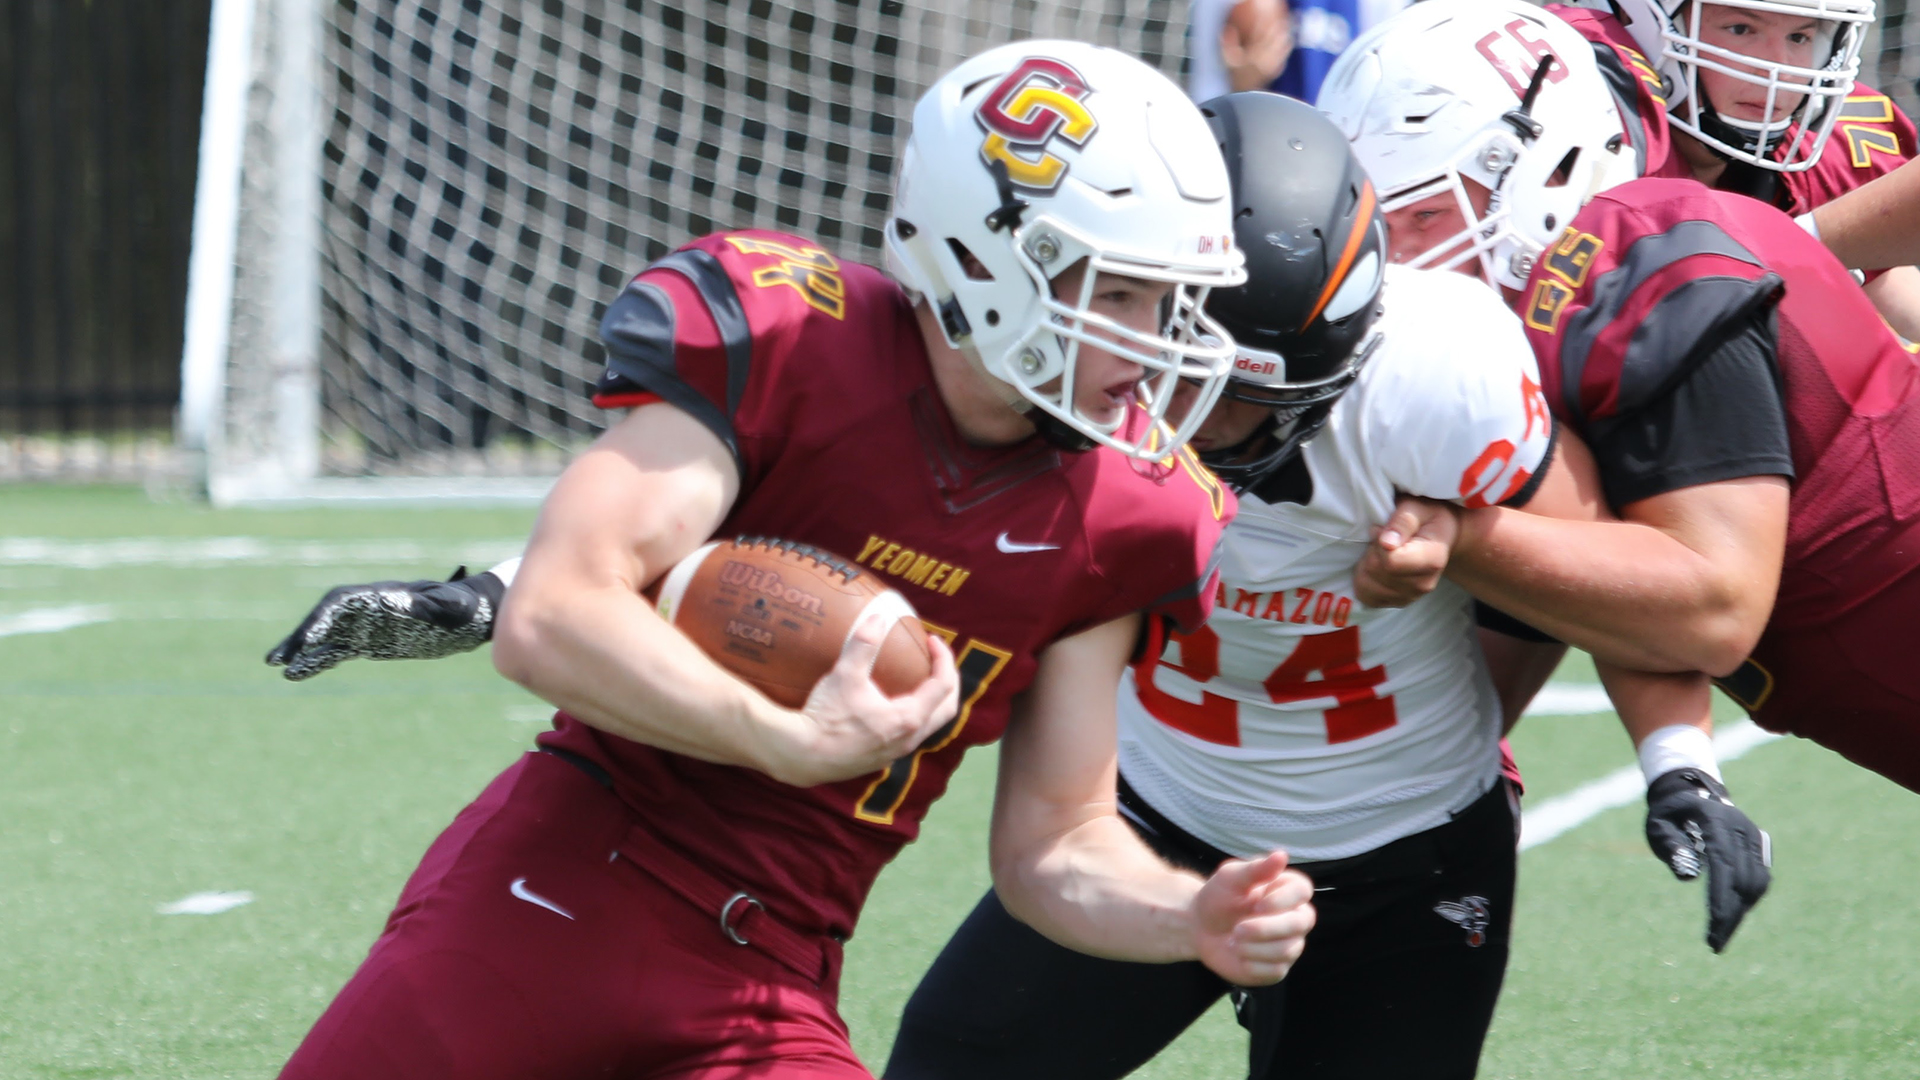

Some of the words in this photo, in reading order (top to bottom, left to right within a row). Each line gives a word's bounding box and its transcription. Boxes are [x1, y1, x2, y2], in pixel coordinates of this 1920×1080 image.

[719, 560, 824, 616] Wilson
[855, 536, 970, 596] YEOMEN
[726, 620, 773, 647] NCAA
[1134, 622, 1398, 748] 24
